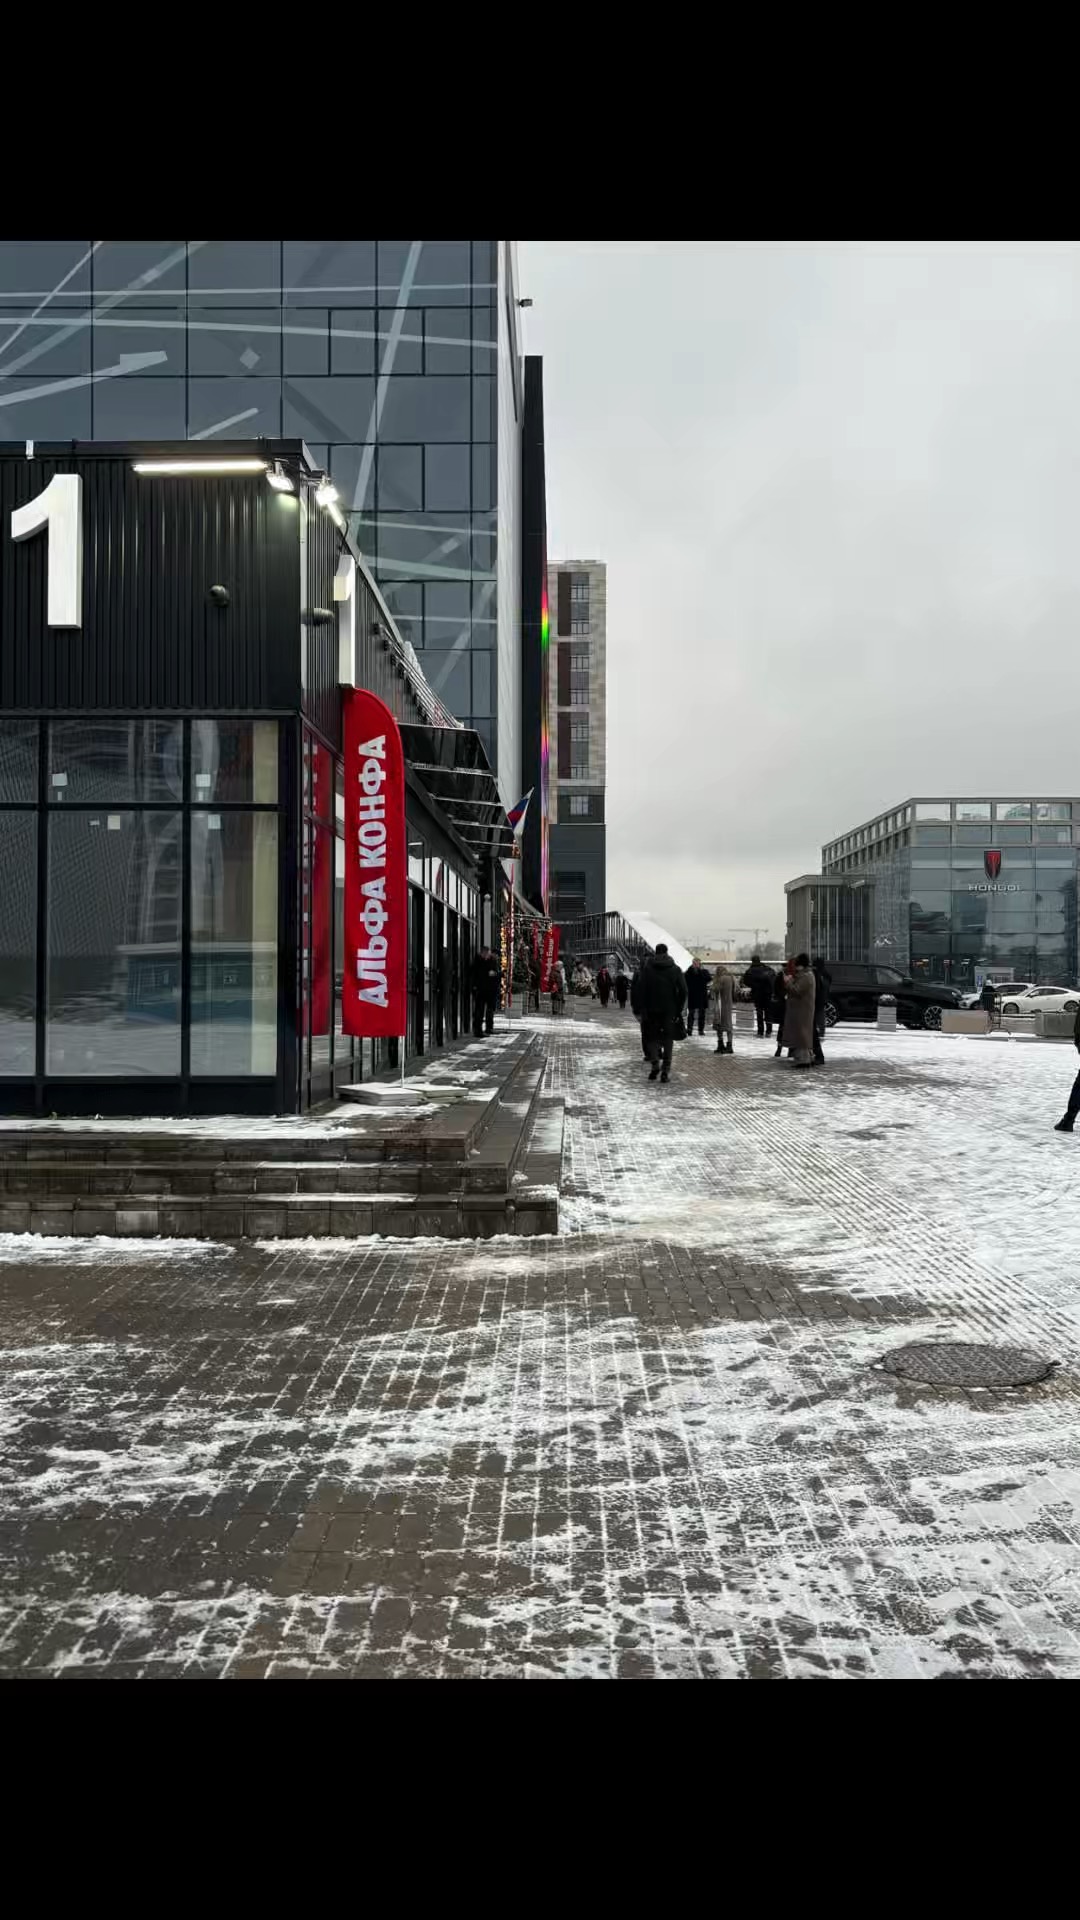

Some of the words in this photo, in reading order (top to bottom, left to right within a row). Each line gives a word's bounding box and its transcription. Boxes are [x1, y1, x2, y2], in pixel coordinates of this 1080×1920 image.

[11, 474, 83, 629] 1
[334, 555, 356, 688] 1
[358, 735, 387, 867] КОНФА
[357, 877, 388, 1008] АЛЬФА
